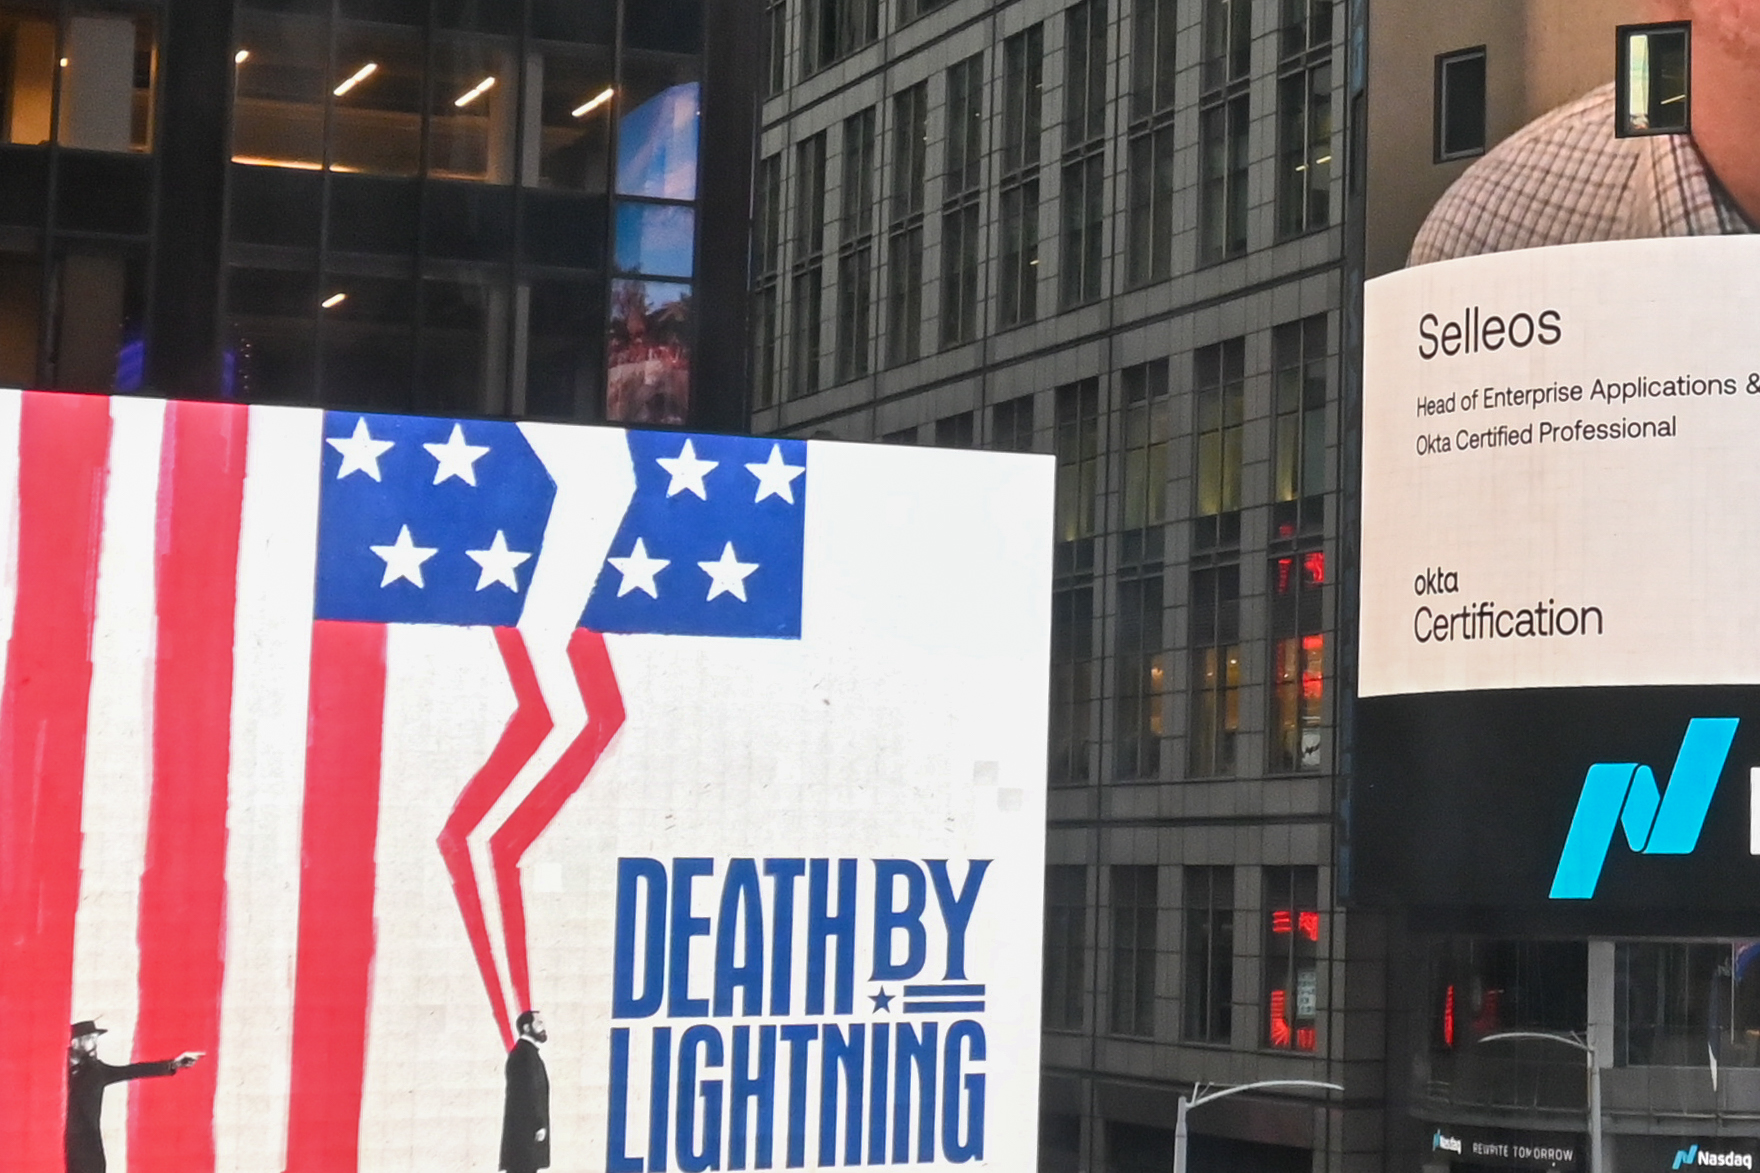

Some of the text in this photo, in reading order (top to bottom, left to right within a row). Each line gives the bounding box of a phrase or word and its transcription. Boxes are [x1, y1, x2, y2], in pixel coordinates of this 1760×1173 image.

[1418, 306, 1562, 360] Selleos
[1416, 396, 1456, 418] Head
[1461, 389, 1479, 411] of
[1483, 382, 1583, 410] Enterprise
[1590, 374, 1737, 405] Applications
[1416, 416, 1677, 456] Okta Certified Professional
[1414, 566, 1459, 596] okta
[1414, 599, 1604, 643] Certification
[611, 857, 995, 1019] DEATH BY
[605, 1019, 987, 1173] LIGHTNING
[1472, 1142, 1509, 1158] REWRITE
[1513, 1146, 1574, 1161] TOMORROW
[1697, 1151, 1752, 1170] Nasdaq
